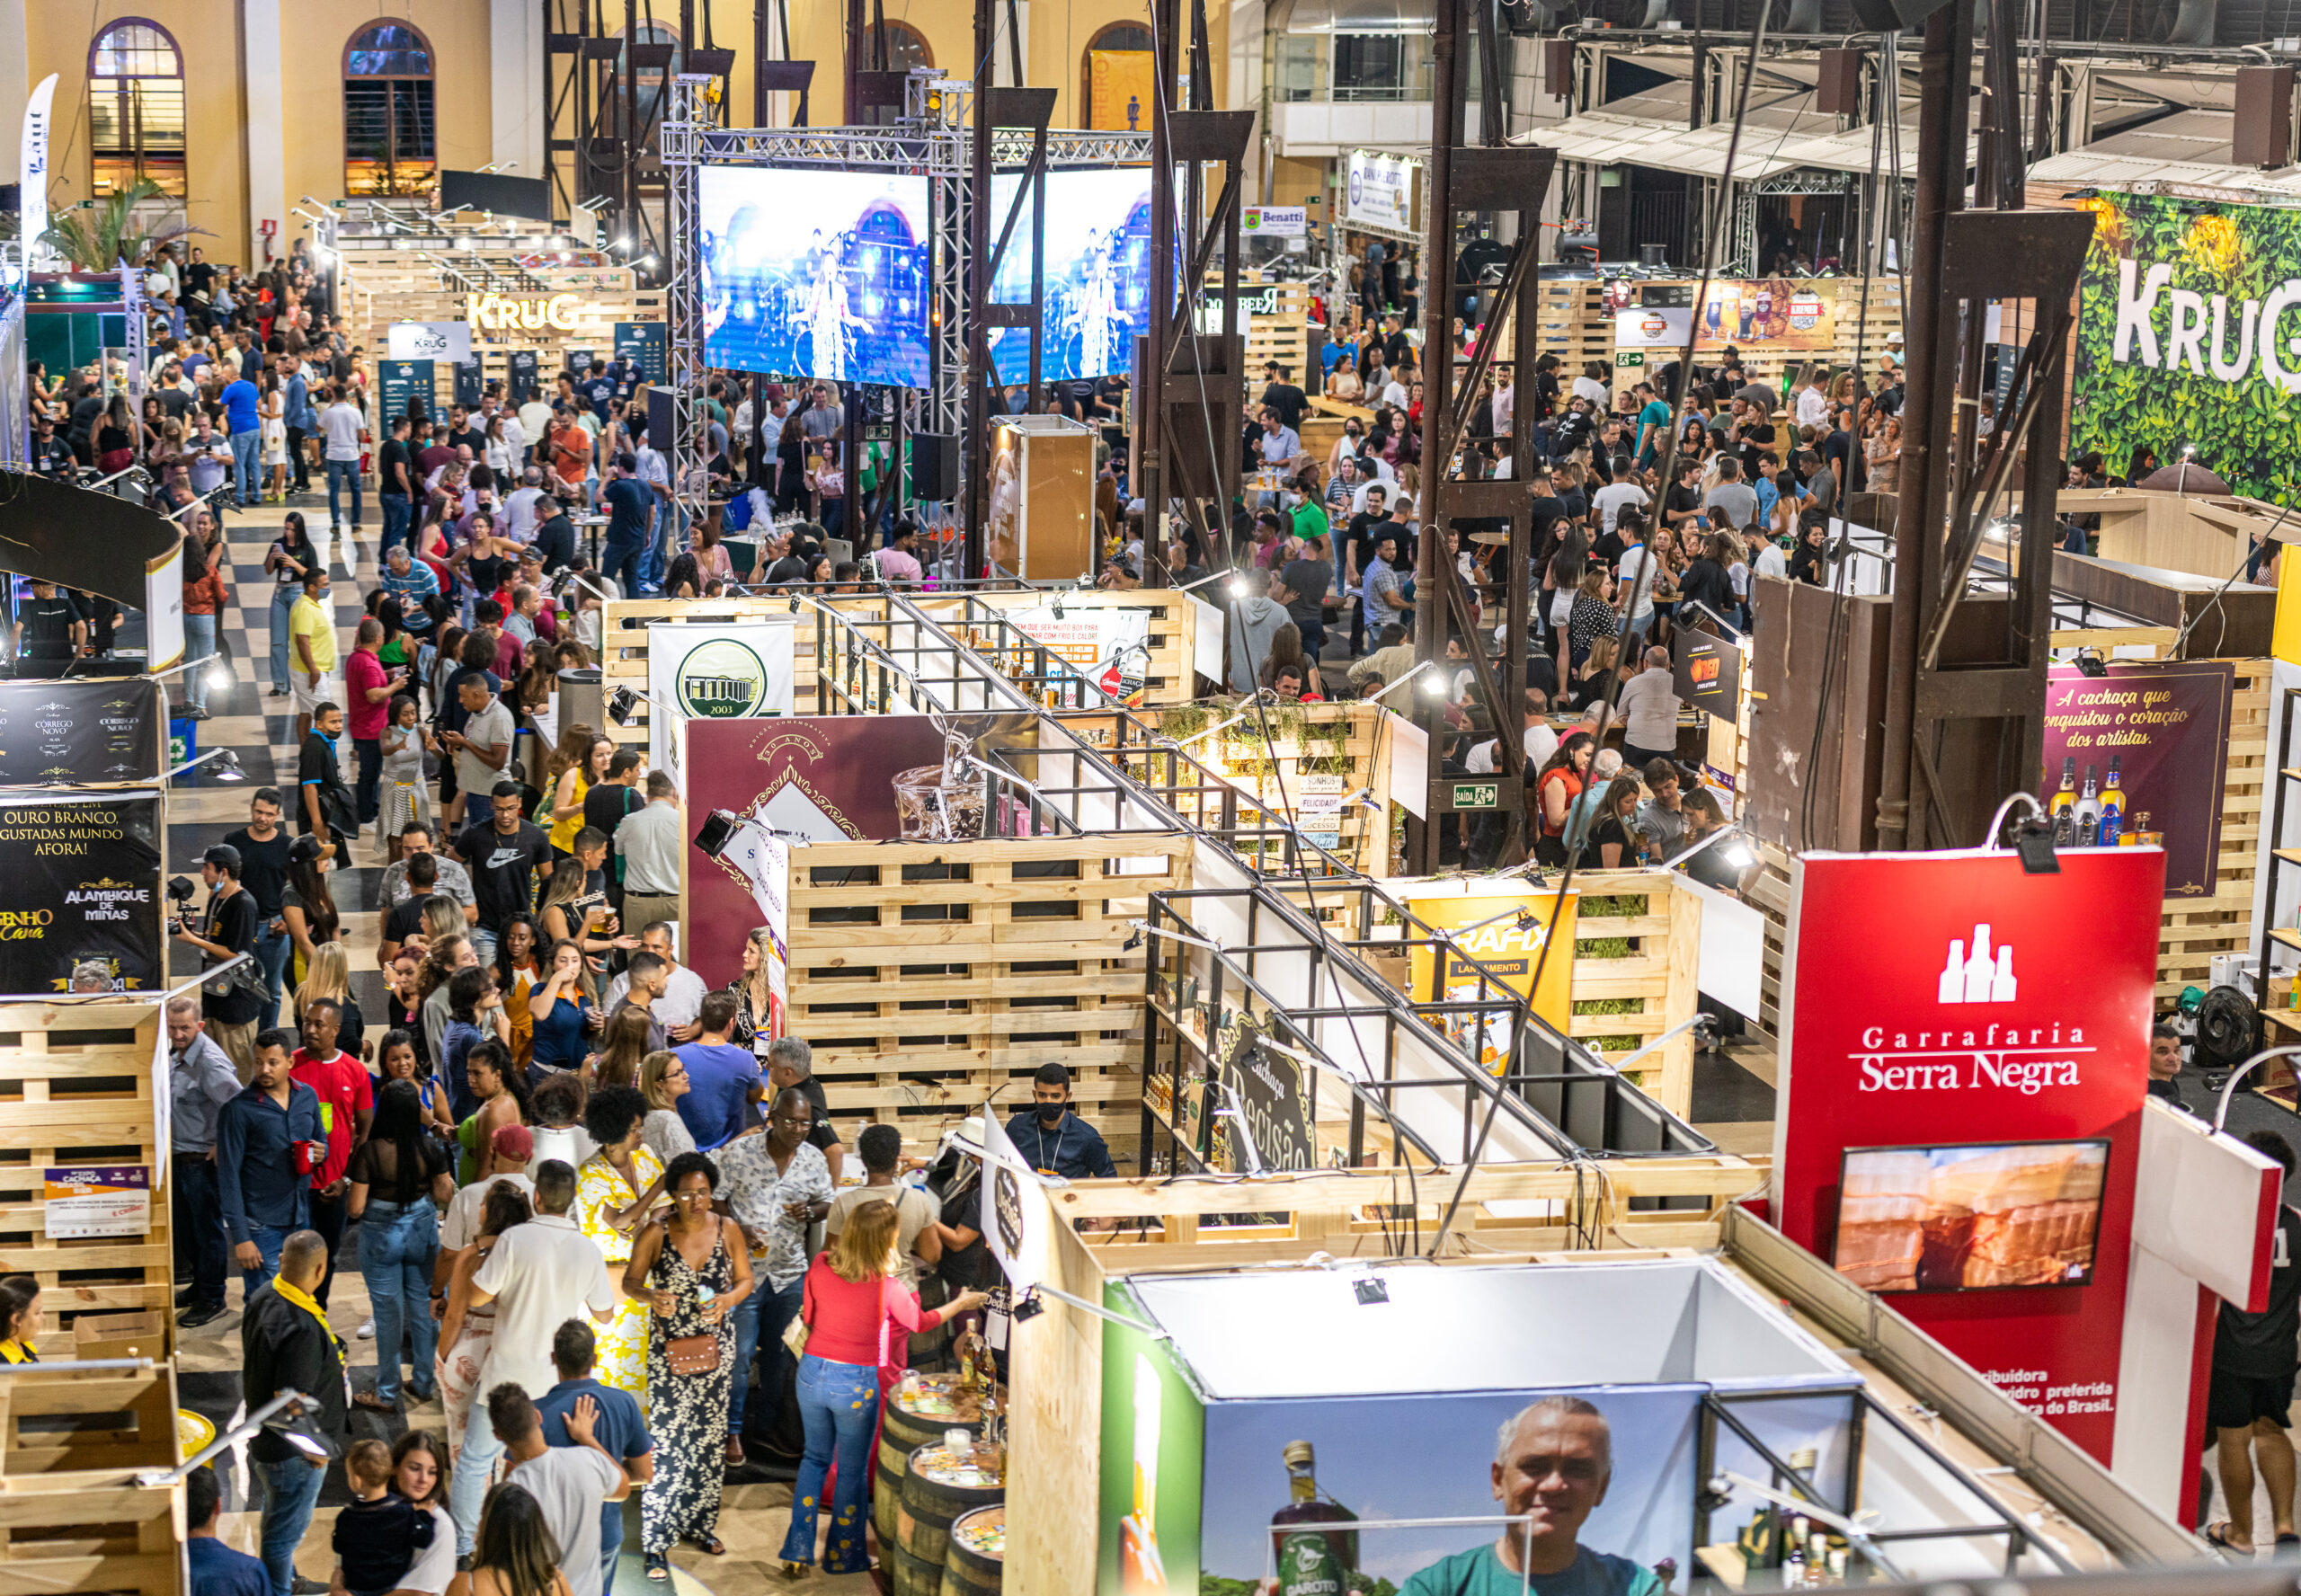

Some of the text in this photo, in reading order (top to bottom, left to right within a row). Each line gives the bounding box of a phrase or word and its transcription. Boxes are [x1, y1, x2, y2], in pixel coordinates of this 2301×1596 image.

[1263, 211, 1303, 222] Benatti
[466, 292, 580, 331] KRUG
[2112, 258, 2301, 394] KRUG
[414, 337, 447, 348] KRUG
[1027, 623, 1039, 631] QUE
[1040, 623, 1052, 631] SER
[1053, 623, 1071, 631] MUITO
[1044, 632, 1056, 640] COM
[2056, 688, 2172, 709] A cachaça que
[710, 705, 733, 714] 2003
[35, 720, 74, 729] CÓRREGO
[99, 716, 139, 725] CÓRREGO
[2043, 707, 2189, 732] onquistou o coração
[776, 720, 831, 747] COMEMORATIVA
[2066, 729, 2152, 747] dos artistas.
[764, 737, 817, 757] 30 ANOS
[1308, 776, 1336, 785] SONHOS
[1456, 790, 1474, 802] SAÍDA
[4, 811, 119, 825] OURO BRANCO,
[69, 829, 123, 840] MUNDO
[34, 842, 88, 856] AFORA!
[493, 848, 520, 859] NIKE
[65, 889, 149, 904] ALAMBIQUE
[573, 890, 605, 907] classic
[85, 910, 129, 920] MINAS
[1457, 962, 1521, 974] LANAMENTO
[1862, 1022, 2083, 1049] Garrafaria
[1859, 1053, 2081, 1095] Serra Negra
[2046, 1381, 2113, 1401] preferida
[2047, 1401, 2065, 1414] do
[2067, 1398, 2115, 1414] Brasil.
